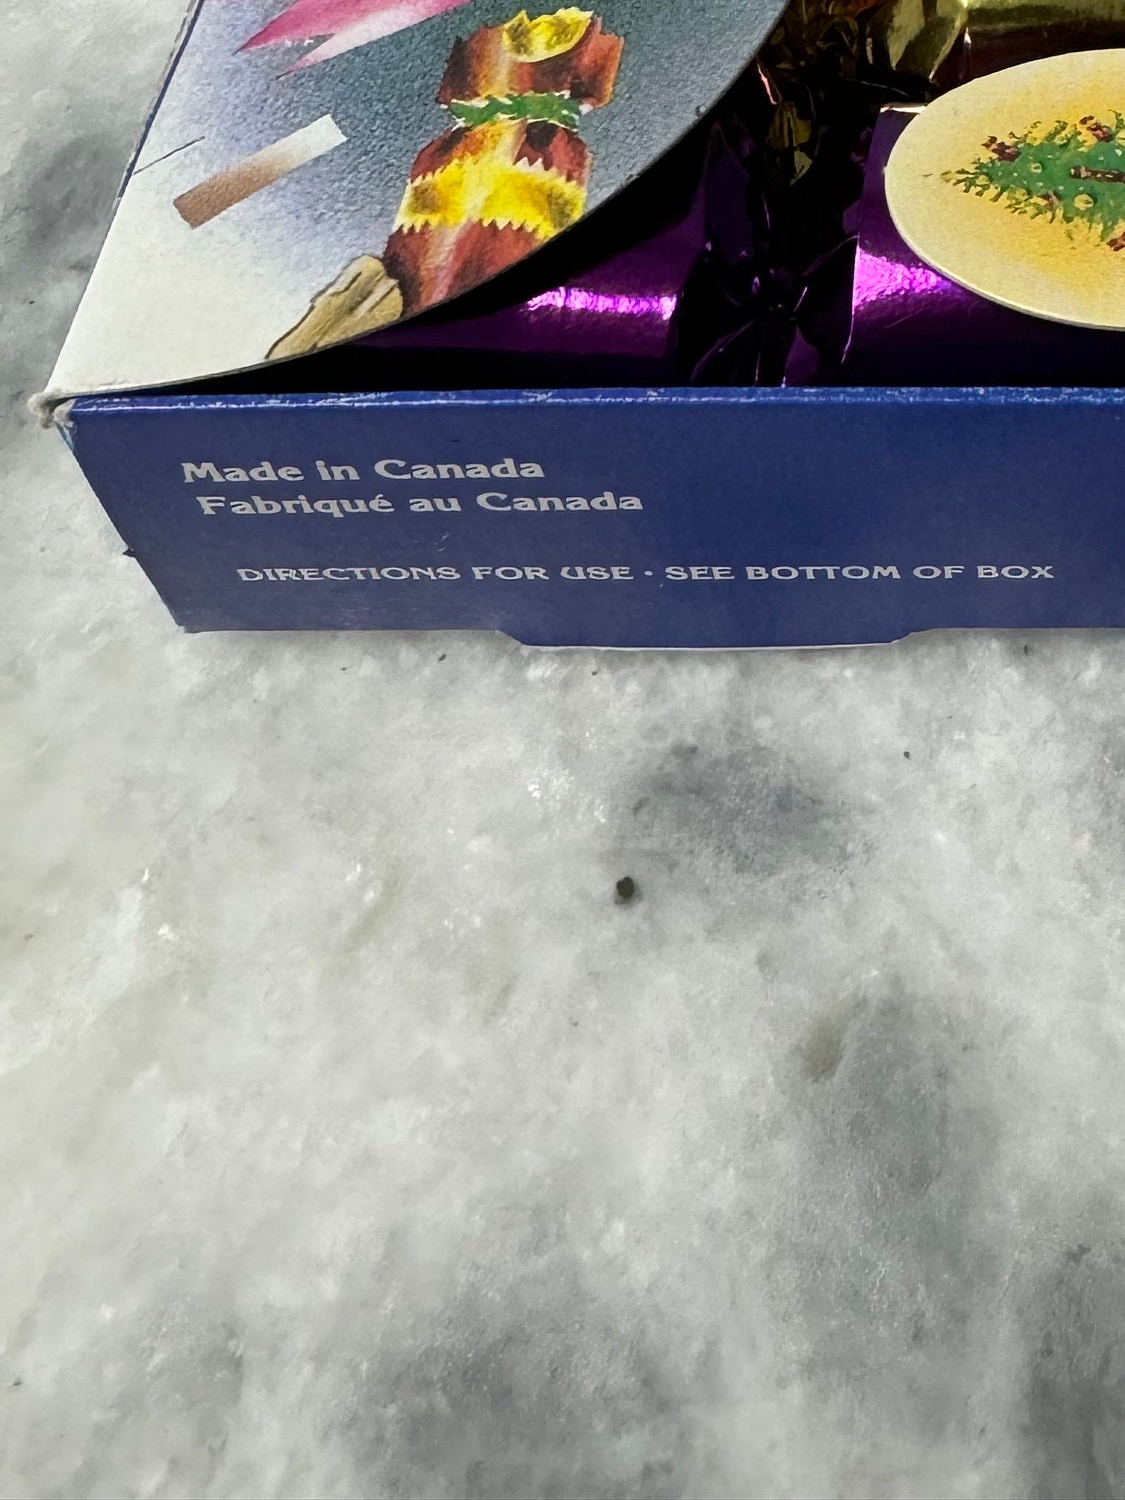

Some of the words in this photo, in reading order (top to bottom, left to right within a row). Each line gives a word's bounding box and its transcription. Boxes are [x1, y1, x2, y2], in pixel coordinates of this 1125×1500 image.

[181, 461, 304, 482] Made
[316, 460, 360, 480] in
[374, 458, 544, 479] Canada
[196, 494, 394, 517] Fabriqué
[409, 498, 461, 511] au
[477, 492, 643, 511] Canada
[237, 567, 460, 581] DIRECTIONS
[472, 567, 549, 579] FOR
[561, 567, 633, 579] USE
[665, 566, 735, 580] SEE
[746, 566, 901, 579] BOTTOM
[913, 566, 964, 579] OF
[977, 566, 1054, 578] BOX
